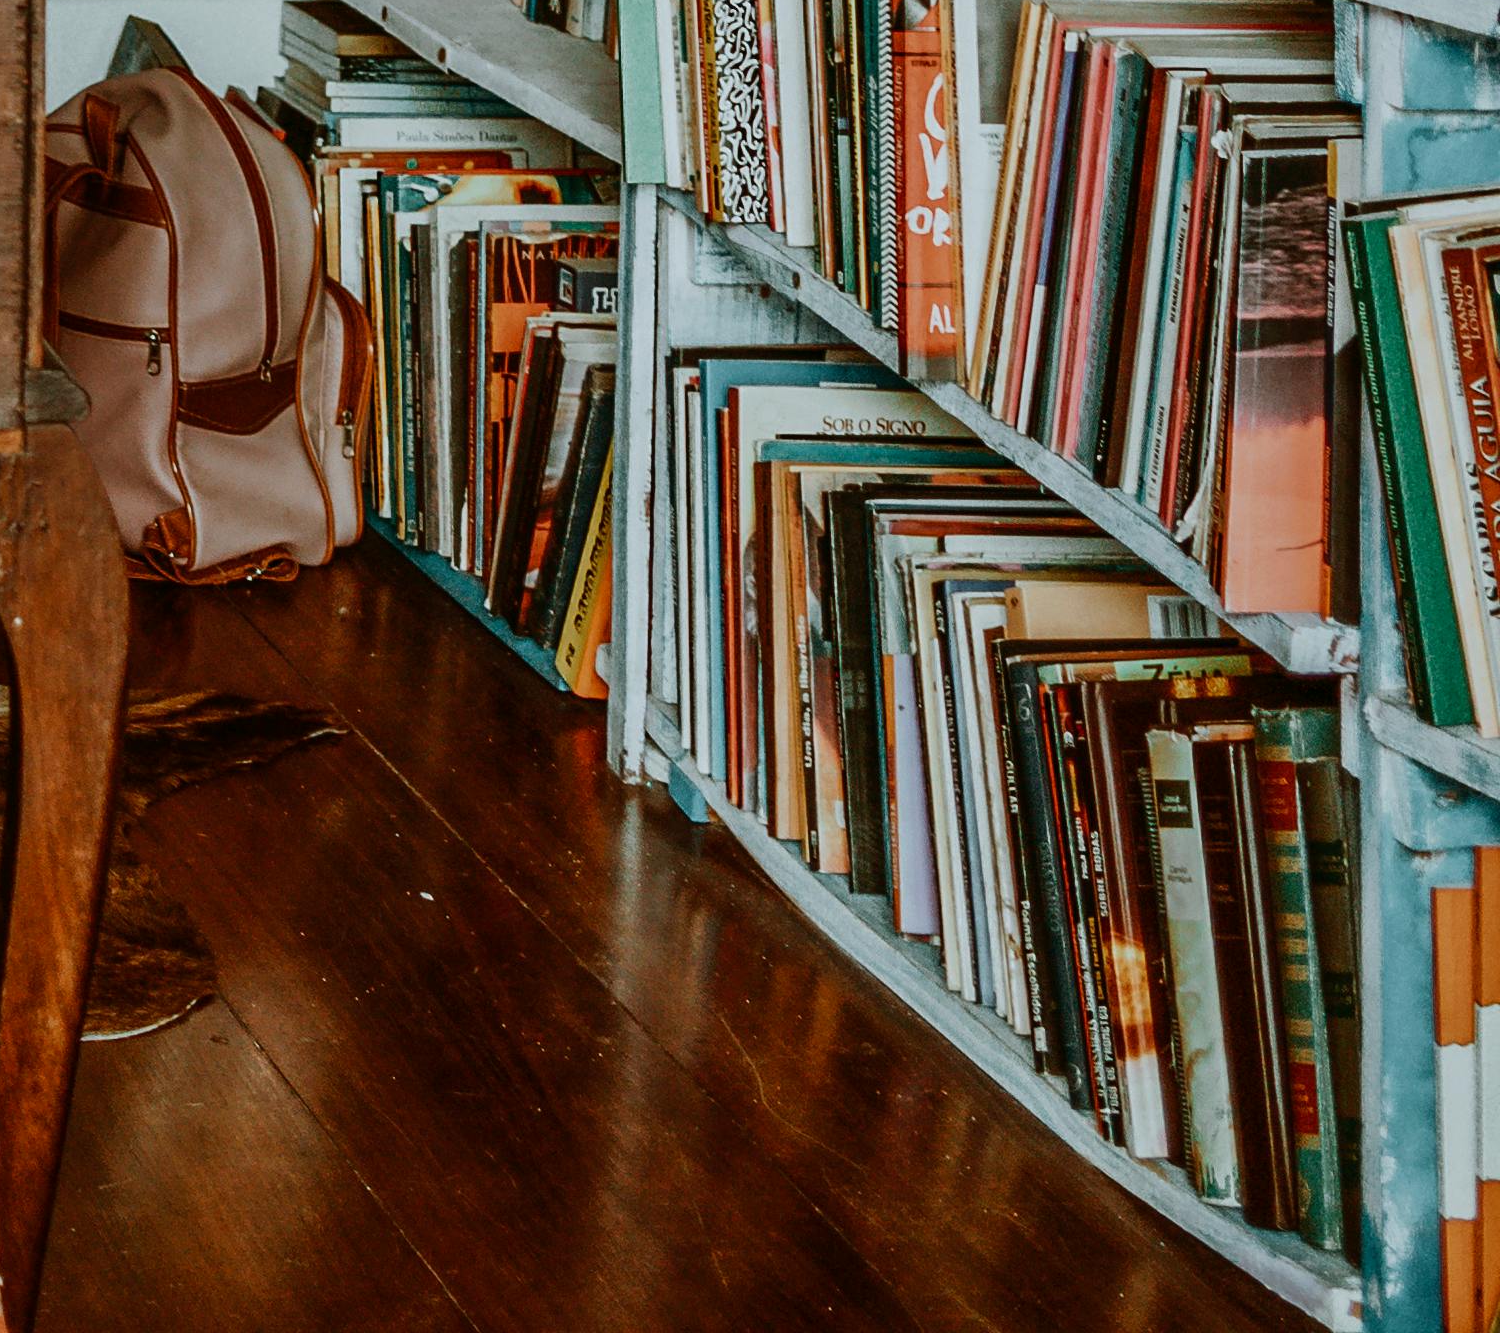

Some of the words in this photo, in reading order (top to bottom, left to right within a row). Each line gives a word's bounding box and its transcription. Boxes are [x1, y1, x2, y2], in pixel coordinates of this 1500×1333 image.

[1326, 281, 1336, 328] Acaso
[1449, 264, 1475, 361] ALEXANDRE
[1463, 283, 1481, 346] LOBÃO
[1357, 300, 1382, 408] conhecimento
[822, 414, 854, 432] SOB
[858, 417, 870, 432] O
[875, 418, 927, 436] SIGNO
[797, 615, 812, 695] liberdade
[1019, 899, 1035, 955] Poemas
[1024, 955, 1043, 1029] Escolhidos
